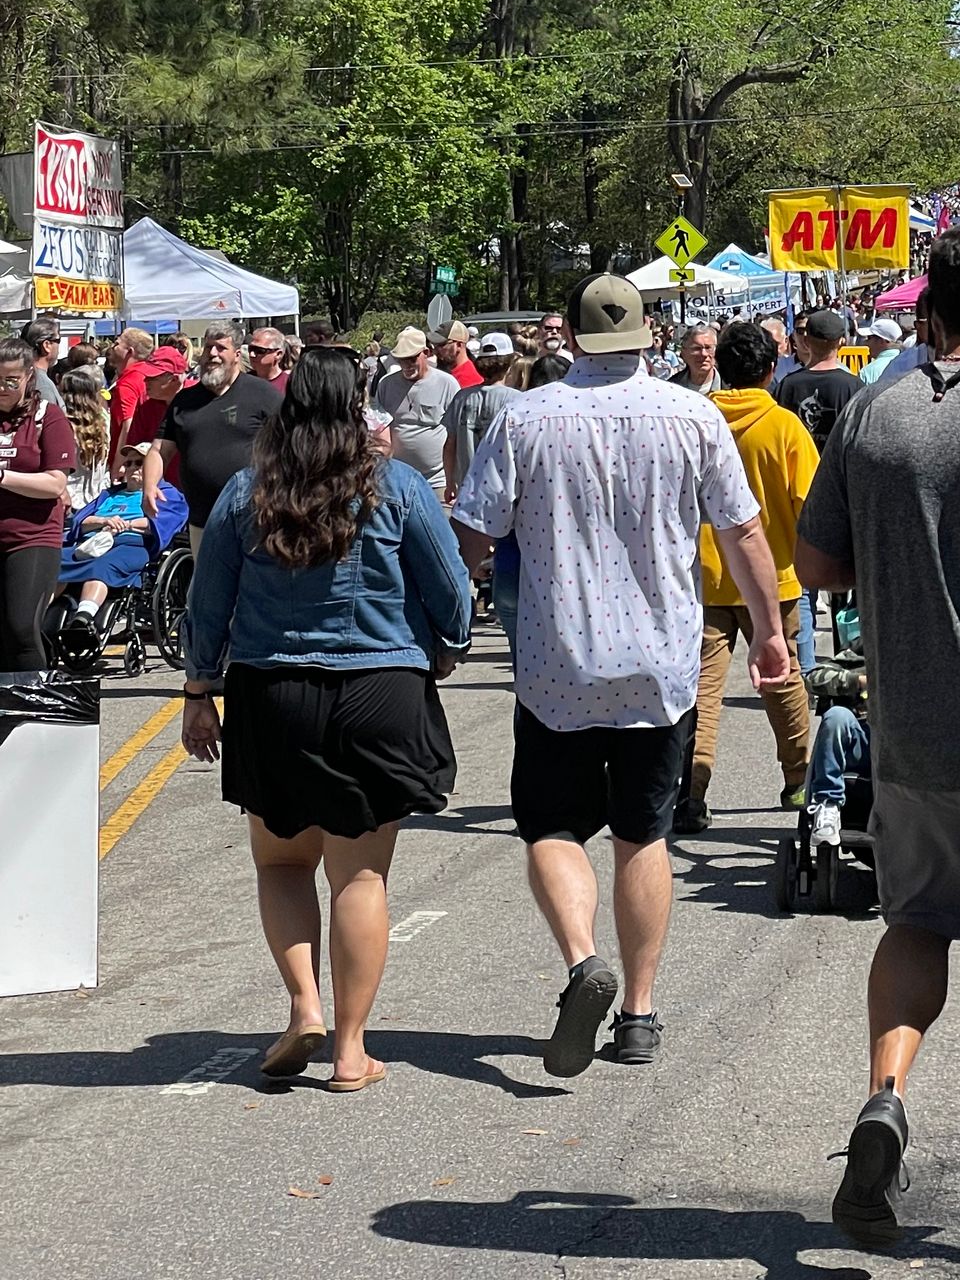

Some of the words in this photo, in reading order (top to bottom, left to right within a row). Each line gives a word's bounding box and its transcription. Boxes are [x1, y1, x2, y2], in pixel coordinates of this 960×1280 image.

[781, 207, 898, 252] ATM
[35, 225, 84, 273] ZEUS
[92, 287, 115, 306] EARS
[746, 300, 782, 313] EXPERT
